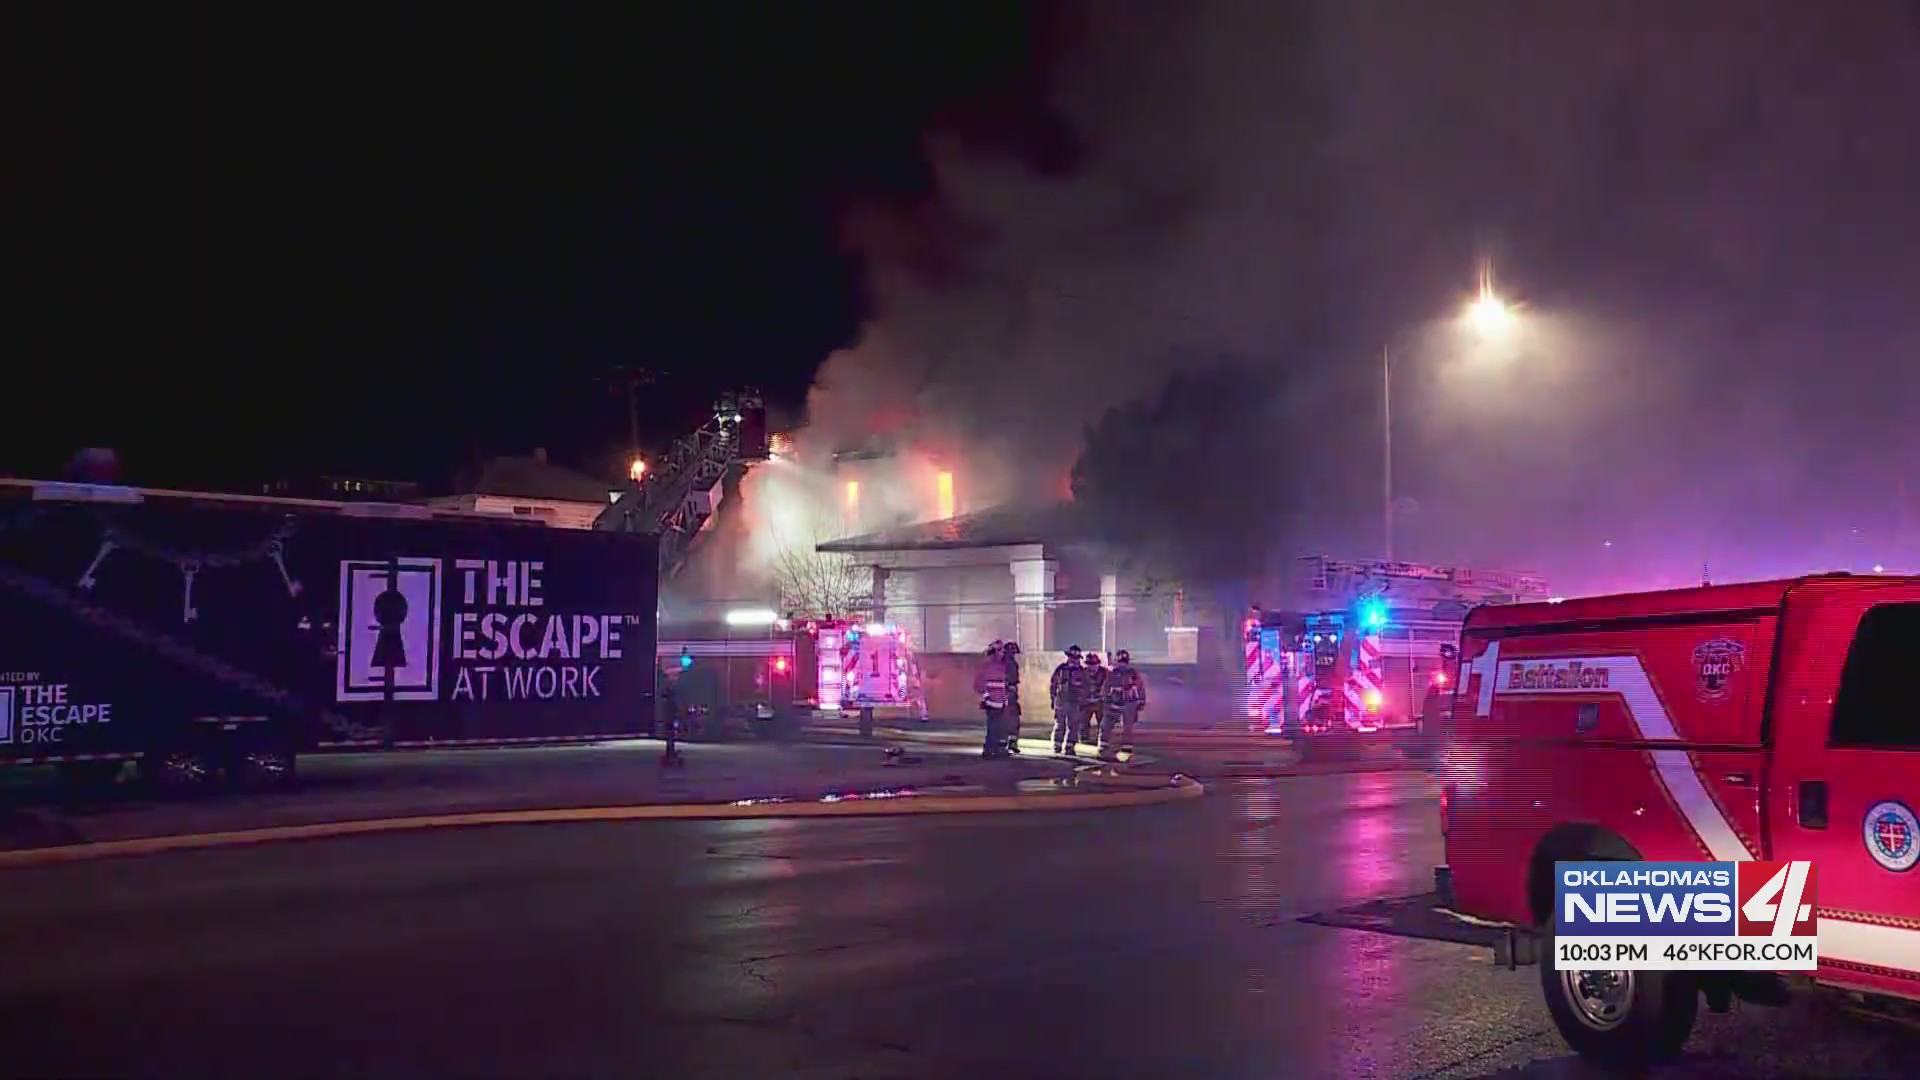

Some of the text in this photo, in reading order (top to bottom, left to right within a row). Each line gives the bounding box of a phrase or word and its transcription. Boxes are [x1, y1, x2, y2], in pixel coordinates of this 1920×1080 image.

[455, 559, 545, 606] THE
[26, 671, 40, 681] BY
[1508, 661, 1609, 689] Battalion
[1703, 663, 1730, 676] OKC
[452, 665, 601, 700] AT WORK
[20, 684, 68, 705] THE
[21, 703, 112, 727] ESCAPE
[21, 726, 64, 744] OKC
